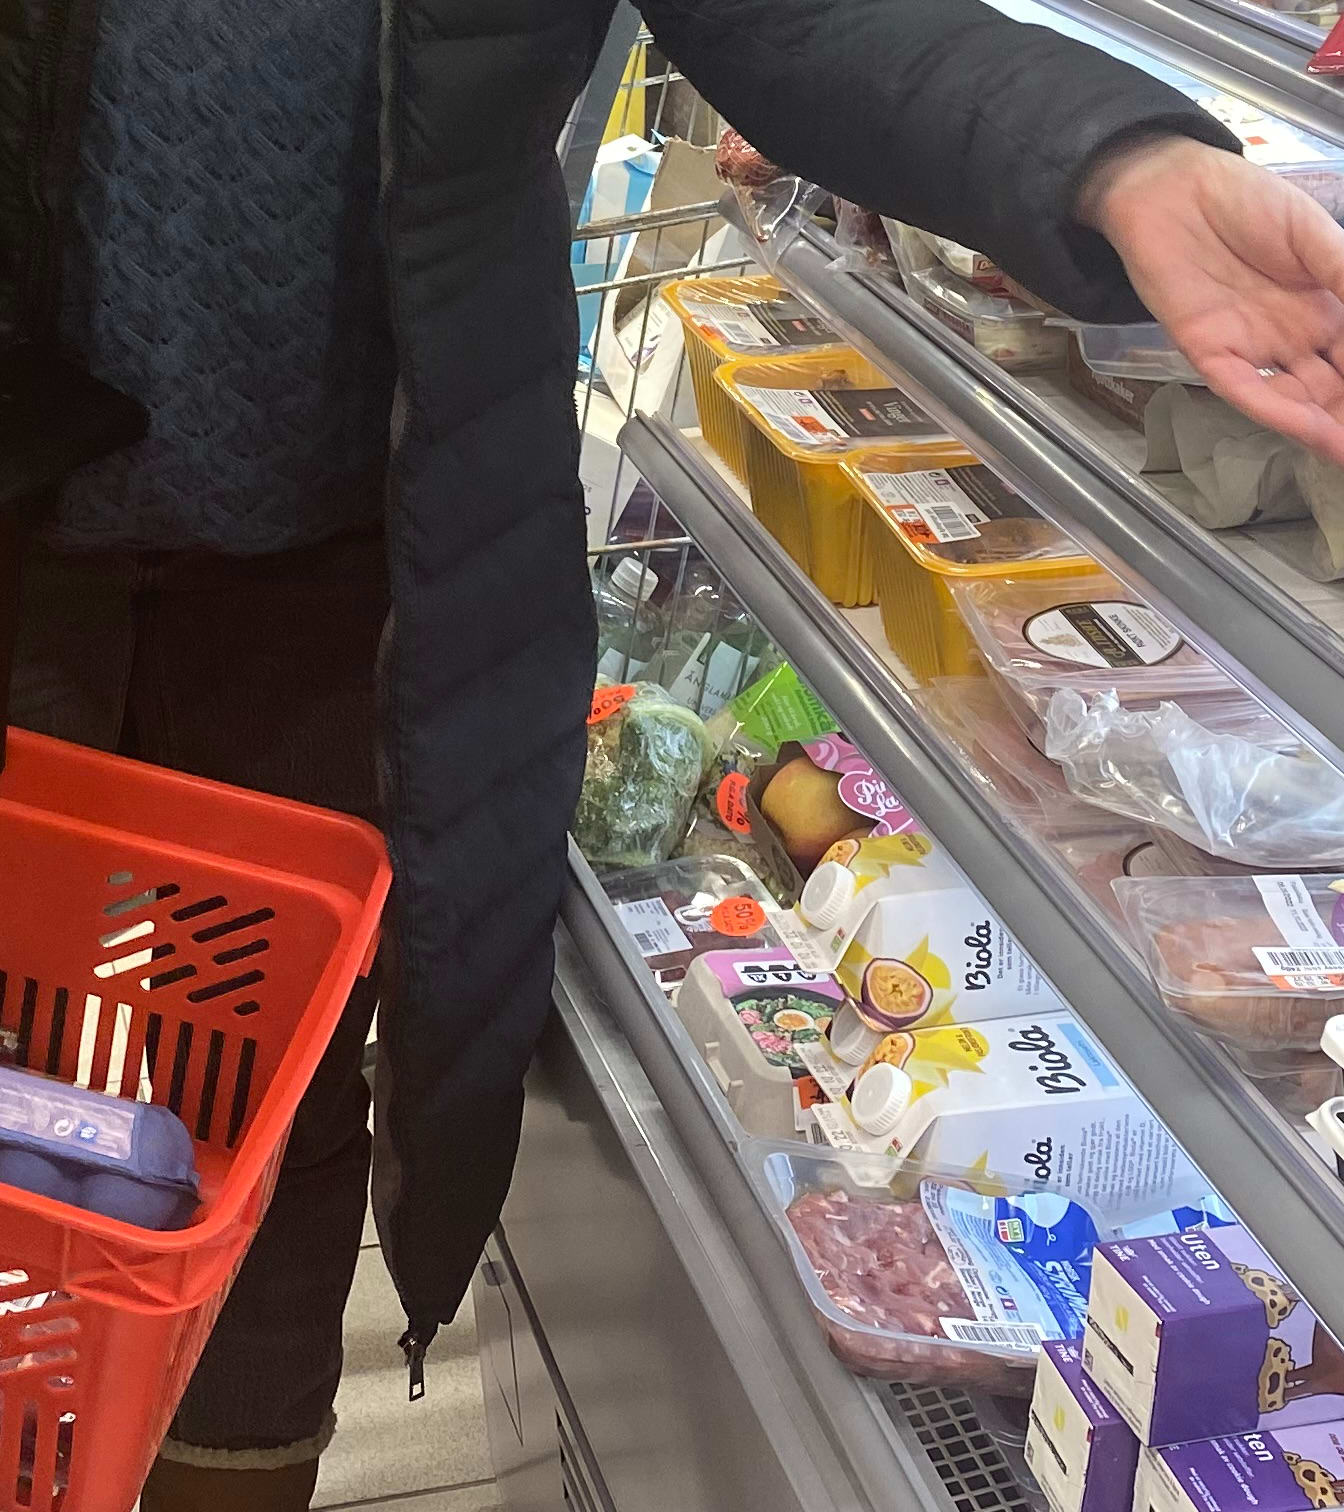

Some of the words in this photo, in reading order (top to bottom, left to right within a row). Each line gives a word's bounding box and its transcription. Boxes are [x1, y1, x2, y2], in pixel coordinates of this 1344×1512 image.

[964, 919, 993, 991] Biola
[1007, 1024, 1087, 1095] Biola
[1109, 1244, 1132, 1263] TINE
[1180, 1233, 1220, 1271] Uten
[1054, 1343, 1075, 1364] TINE
[1243, 1432, 1276, 1462] ten
